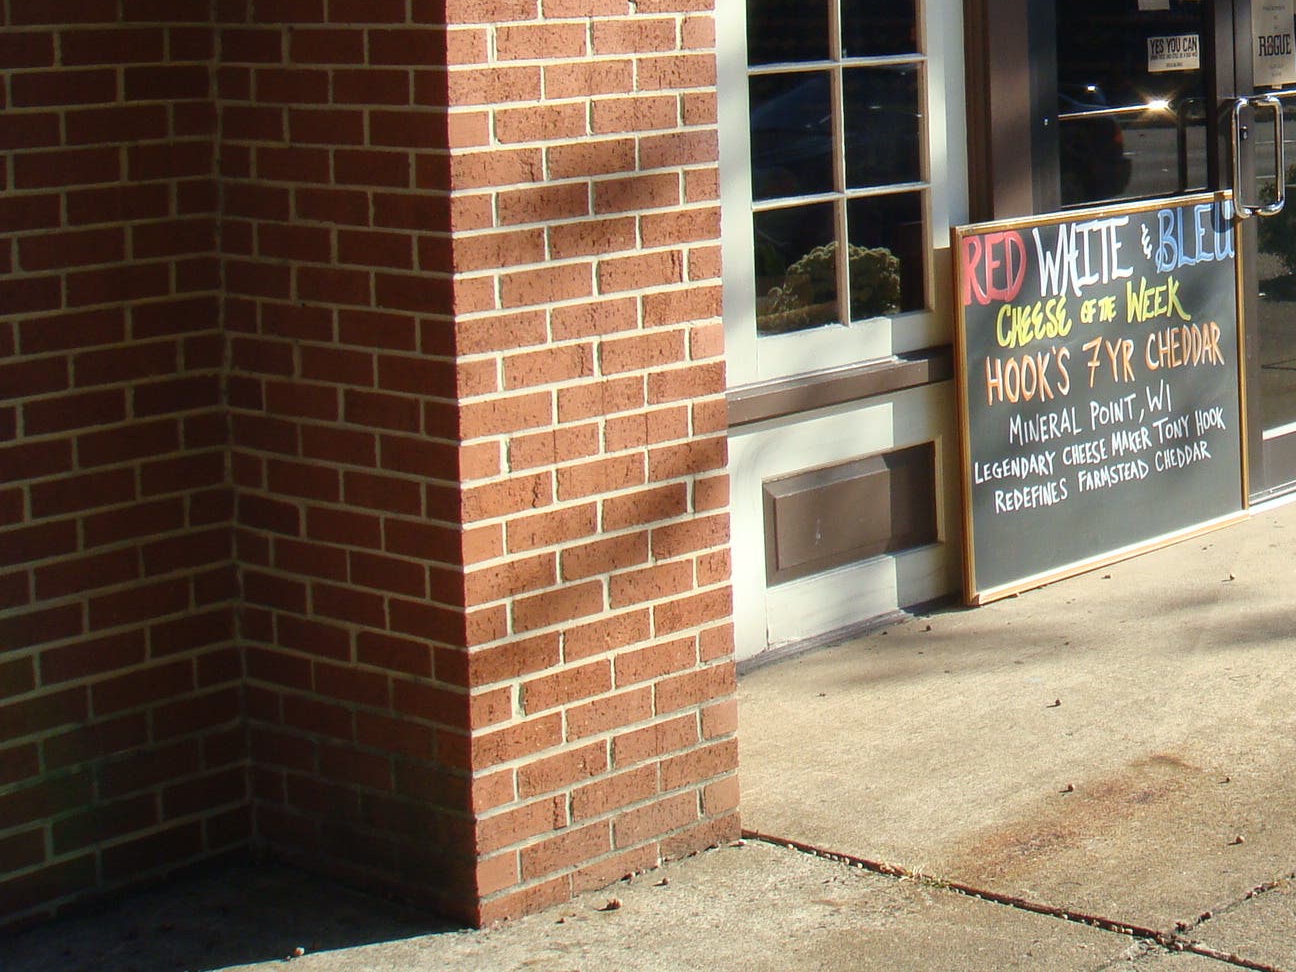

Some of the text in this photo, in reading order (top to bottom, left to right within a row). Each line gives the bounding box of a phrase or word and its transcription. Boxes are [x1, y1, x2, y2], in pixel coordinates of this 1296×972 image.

[1151, 36, 1198, 54] YES YOU CAN
[1258, 33, 1292, 57] ROGUE
[962, 199, 1236, 306] RED WHITE & BLEU
[996, 275, 1191, 349] CHEESE OF THE WEEK
[983, 321, 1226, 406] HOOK'S 7 YR CHEDDAR
[974, 406, 1226, 485] LEGENDARY CHEESE MAKER TONY HOOK
[1009, 378, 1173, 447] MINERAL POINT, WI
[994, 440, 1212, 515] REDEFINES FARMSTEAD CHEDDAR
